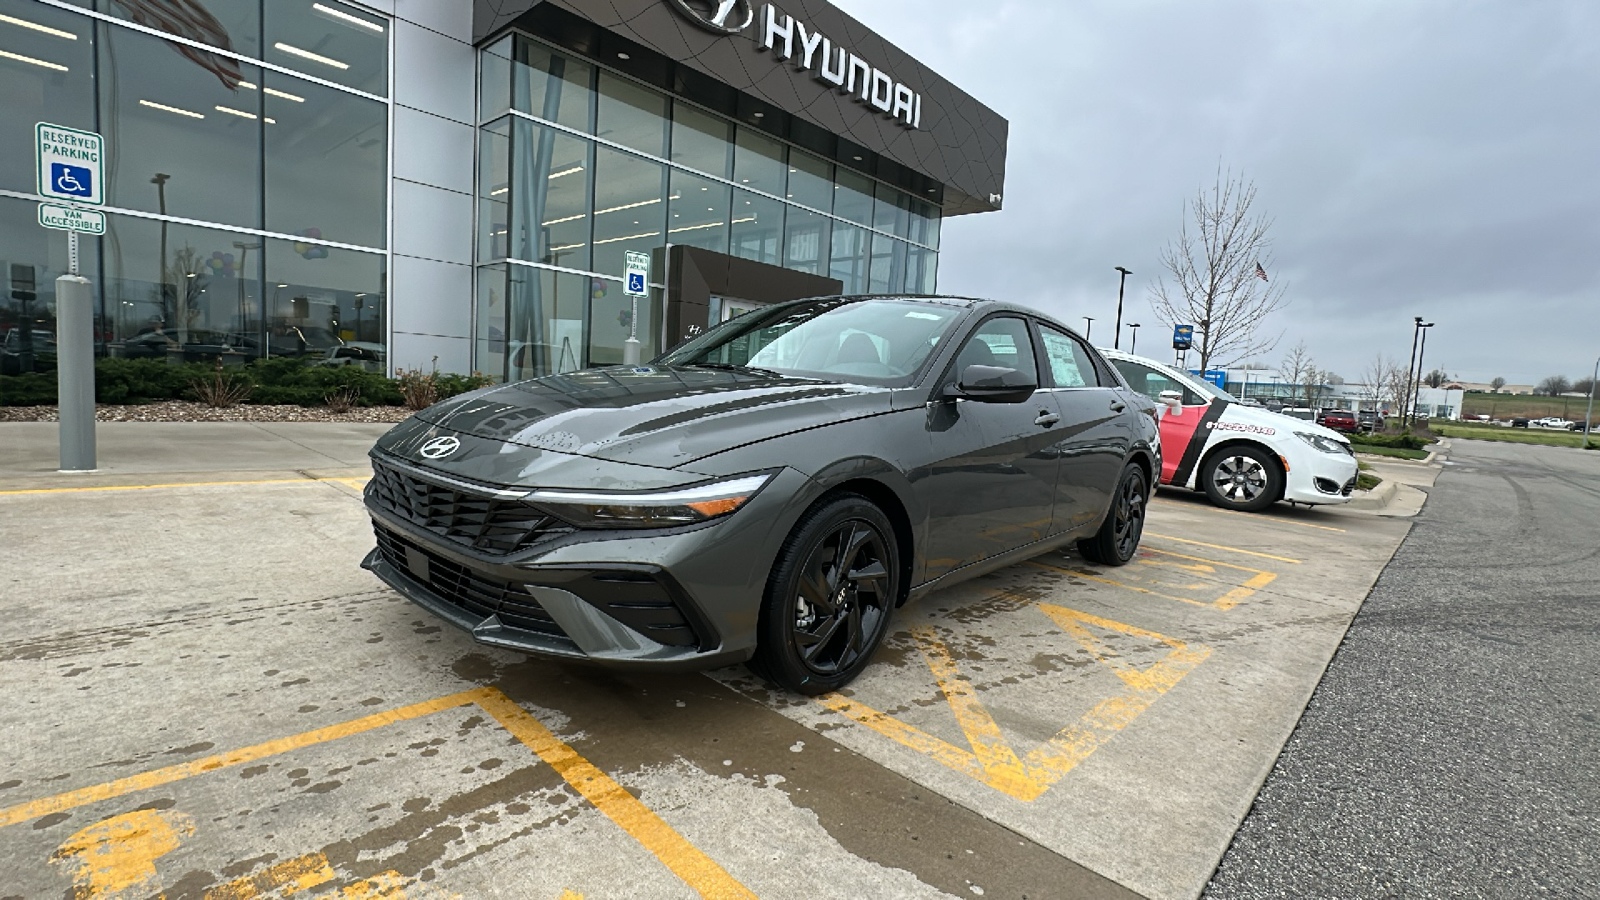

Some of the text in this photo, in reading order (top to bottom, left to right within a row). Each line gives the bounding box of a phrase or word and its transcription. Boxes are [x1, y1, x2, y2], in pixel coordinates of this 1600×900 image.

[763, 3, 921, 129] HYUNDAI
[43, 130, 97, 150] RESERVED
[43, 143, 98, 162] PARKING
[45, 216, 100, 230] ACCESSIBLE
[64, 210, 82, 219] VAN
